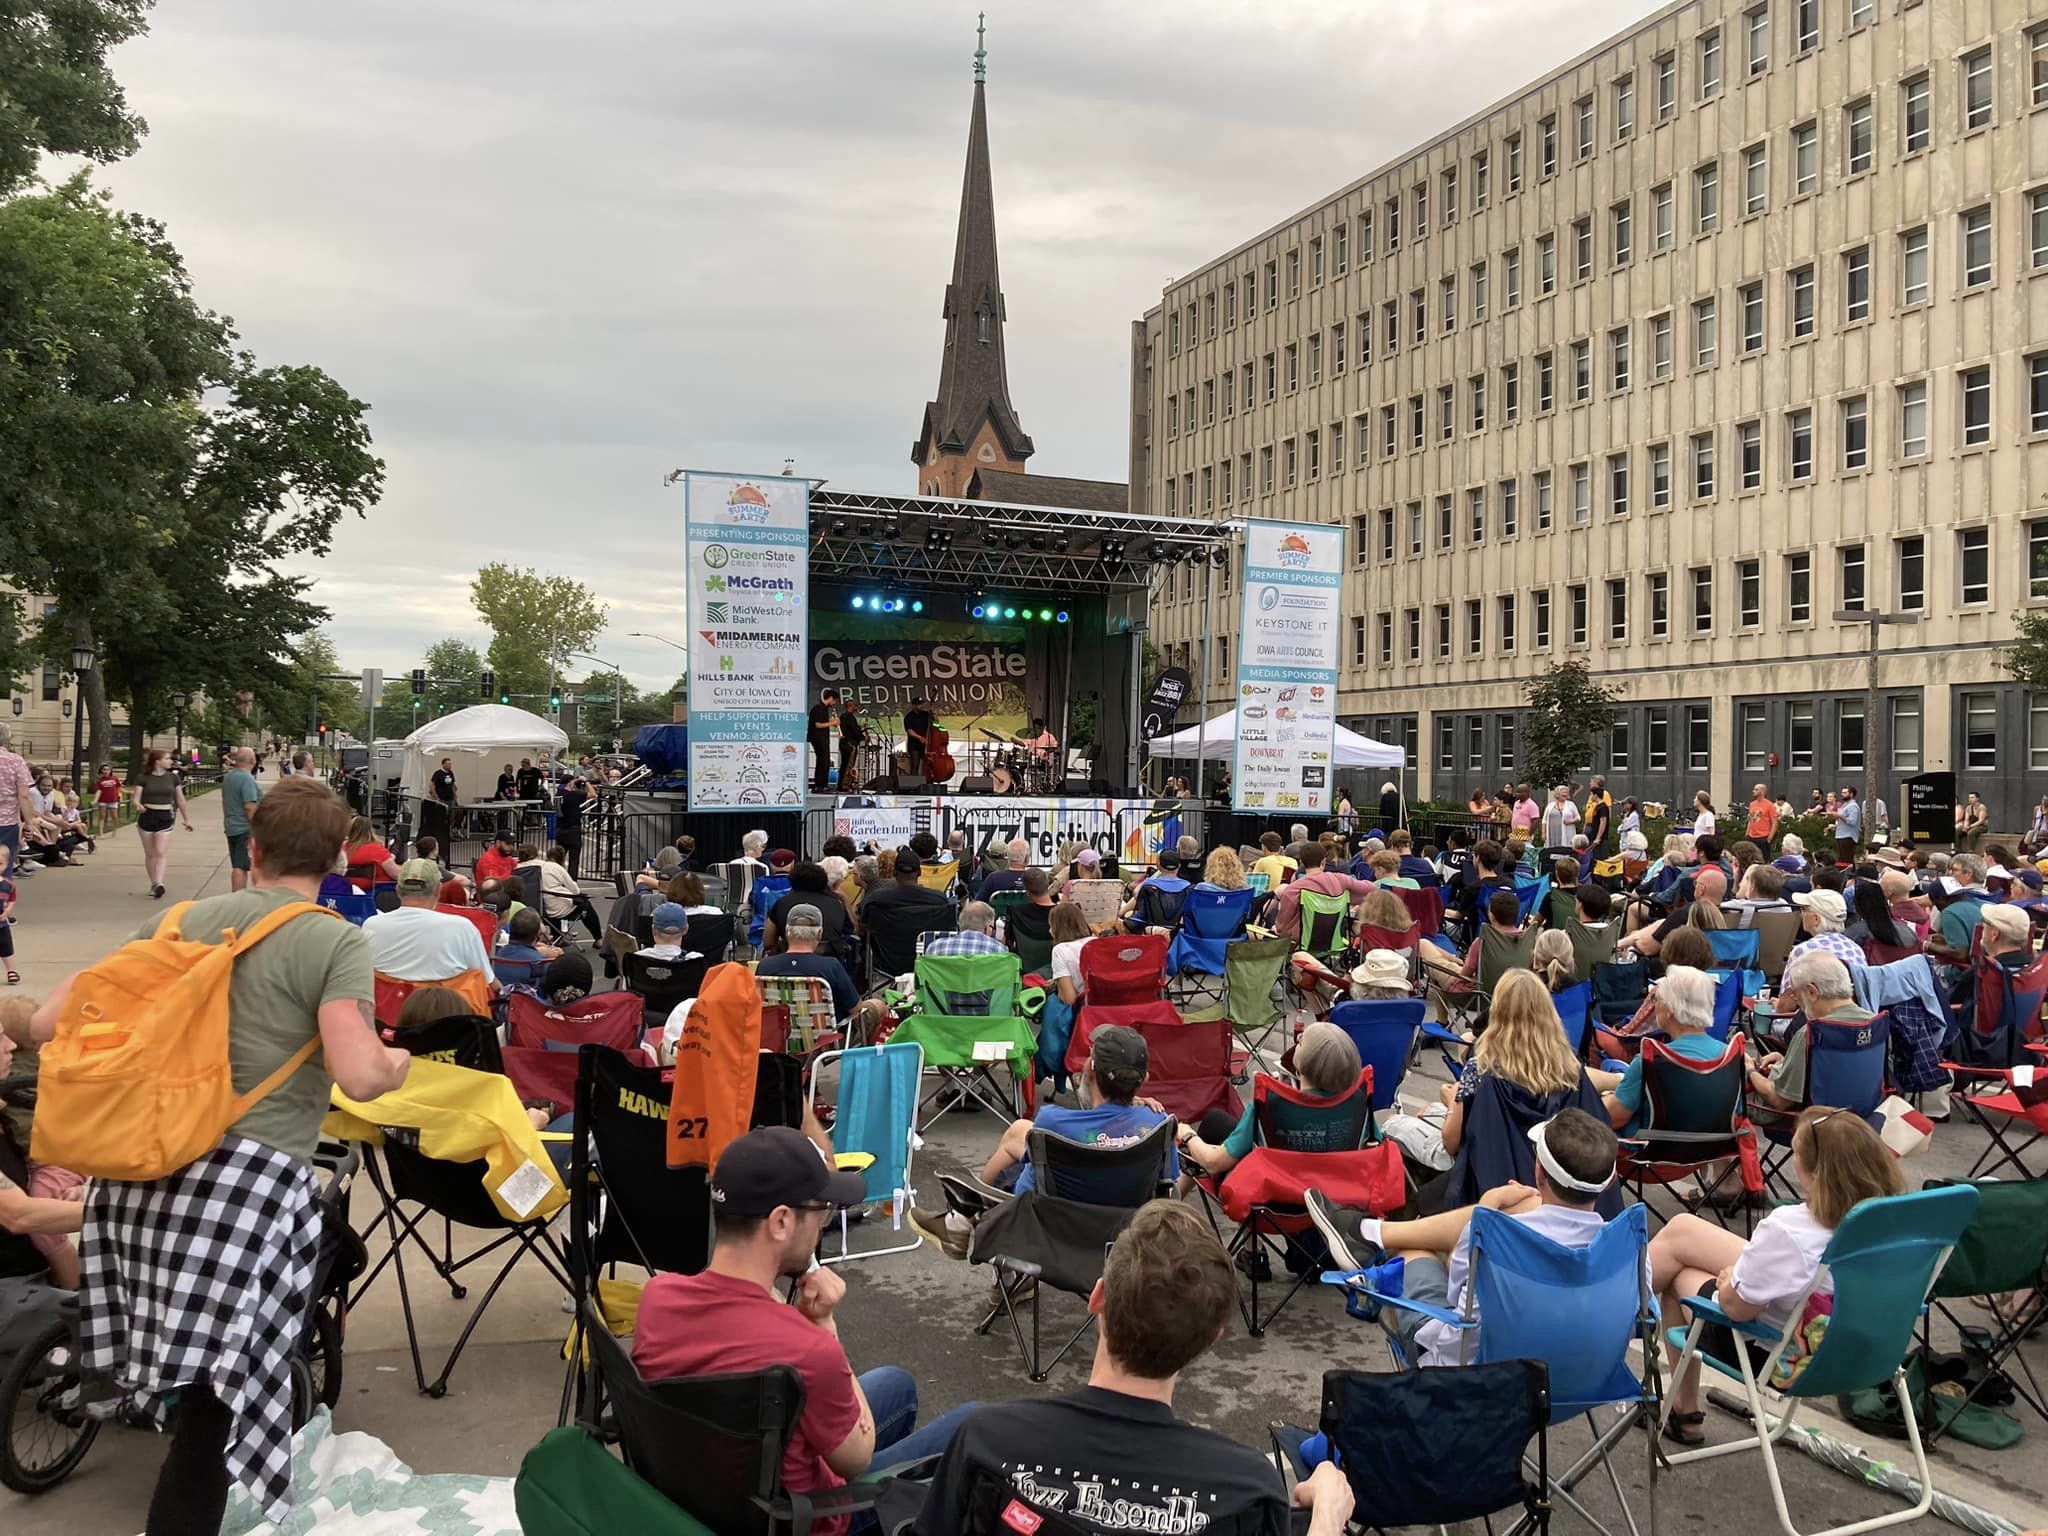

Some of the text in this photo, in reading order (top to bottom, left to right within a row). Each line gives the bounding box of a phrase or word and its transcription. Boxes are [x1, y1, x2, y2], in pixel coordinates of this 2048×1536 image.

[689, 527, 807, 544] PRESENTING SPONSORS
[730, 549, 795, 562] GreenState
[730, 560, 788, 569] CREDIT UNION
[727, 575, 794, 590] McGrath
[1250, 570, 1337, 585] PREMIER SPONSORS
[732, 606, 793, 616] MidWestOne
[1255, 618, 1328, 631] KEYSTONE IT
[716, 631, 800, 643] MIDAMERICAN
[716, 641, 752, 649] ENERGY
[1256, 644, 1276, 656] IOWA
[1294, 646, 1325, 658] COUNCIL
[814, 645, 1027, 682] GreenState
[698, 673, 755, 682] HILLS BANK
[1249, 668, 1329, 681] MEDIA SPONSORS
[820, 683, 1004, 705] CREDIT UNION
[700, 712, 799, 722] HELP SUPPORT THESE
[733, 722, 770, 731] EVENTS
[709, 731, 750, 741] VENMO:
[953, 804, 1025, 822] Iowa City
[851, 825, 910, 835] Garden Inn
[676, 1117, 709, 1139] 27
[1002, 1462, 1217, 1502] INDEPENDENCE
[1006, 1471, 1069, 1513] Jazz
[1068, 1480, 1211, 1536] Ensemble
